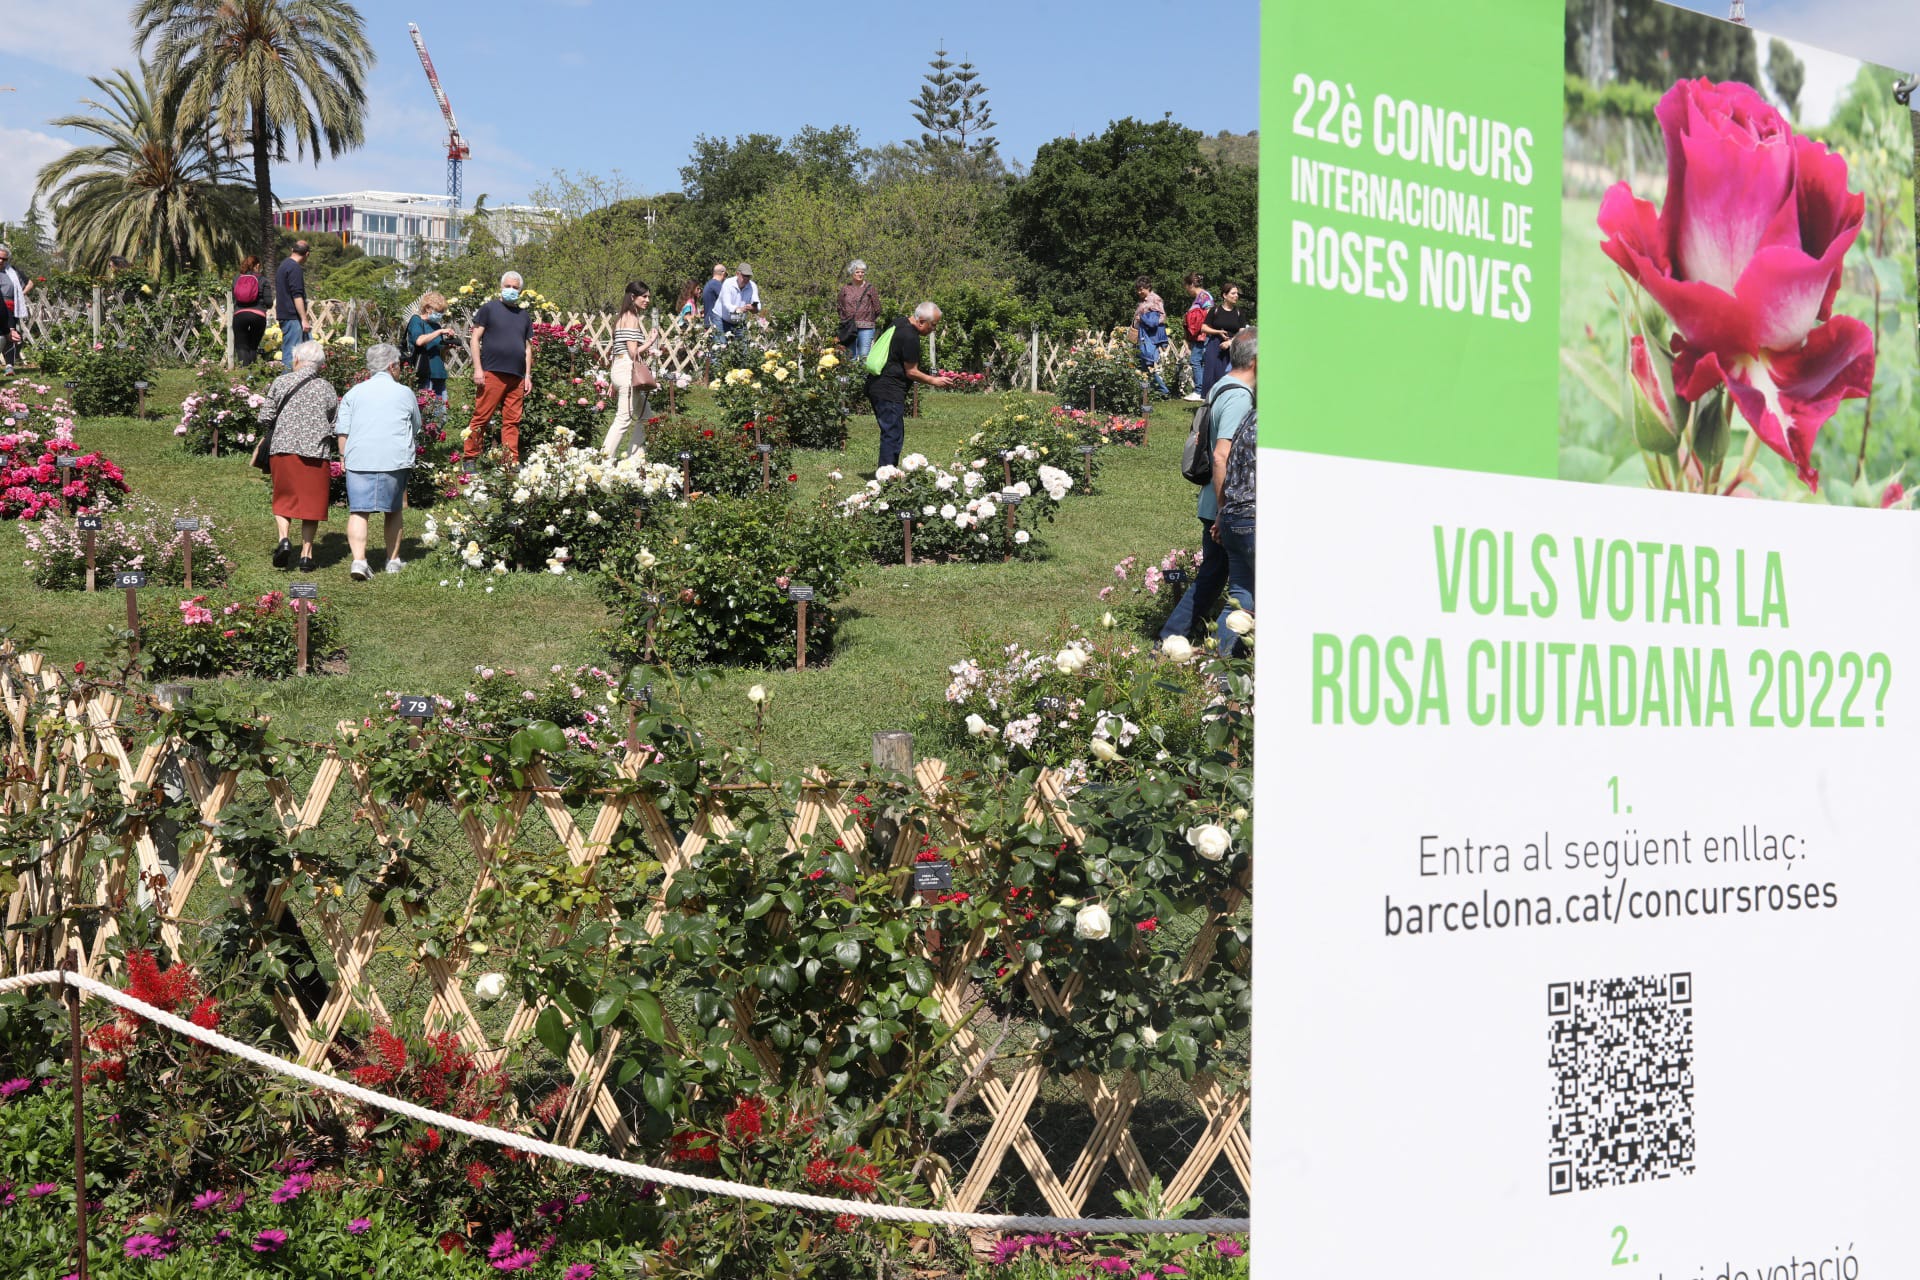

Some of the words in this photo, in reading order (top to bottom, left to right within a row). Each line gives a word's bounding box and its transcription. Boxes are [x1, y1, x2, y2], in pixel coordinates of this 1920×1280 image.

[1293, 74, 1362, 147] 22è
[1374, 95, 1532, 185] CONCURS
[1292, 156, 1495, 241] INTERNACIONAL
[1503, 202, 1532, 248] DE
[1292, 221, 1408, 301] ROSES
[1420, 246, 1531, 322] NOVES
[84, 519, 97, 527] 64
[122, 575, 138, 584] 65
[1168, 572, 1180, 580] 67
[1434, 525, 1558, 618] VOLS
[1574, 537, 1720, 624] VOTAR
[1737, 549, 1789, 628] LA
[1042, 697, 1059, 708] 78
[1313, 633, 1449, 726] ROSA
[1468, 640, 1734, 727] CIUTADANA
[1750, 649, 1892, 728] 2022?
[408, 701, 427, 713] 79
[1609, 776, 1632, 813] 1.
[1421, 836, 1509, 876] Entra
[1524, 832, 1552, 870] al
[1565, 830, 1691, 879] següent
[1705, 825, 1805, 870] enllaç:
[1385, 878, 1838, 937] barcelona.cat/concursroses
[1612, 1226, 1639, 1265] 2.
